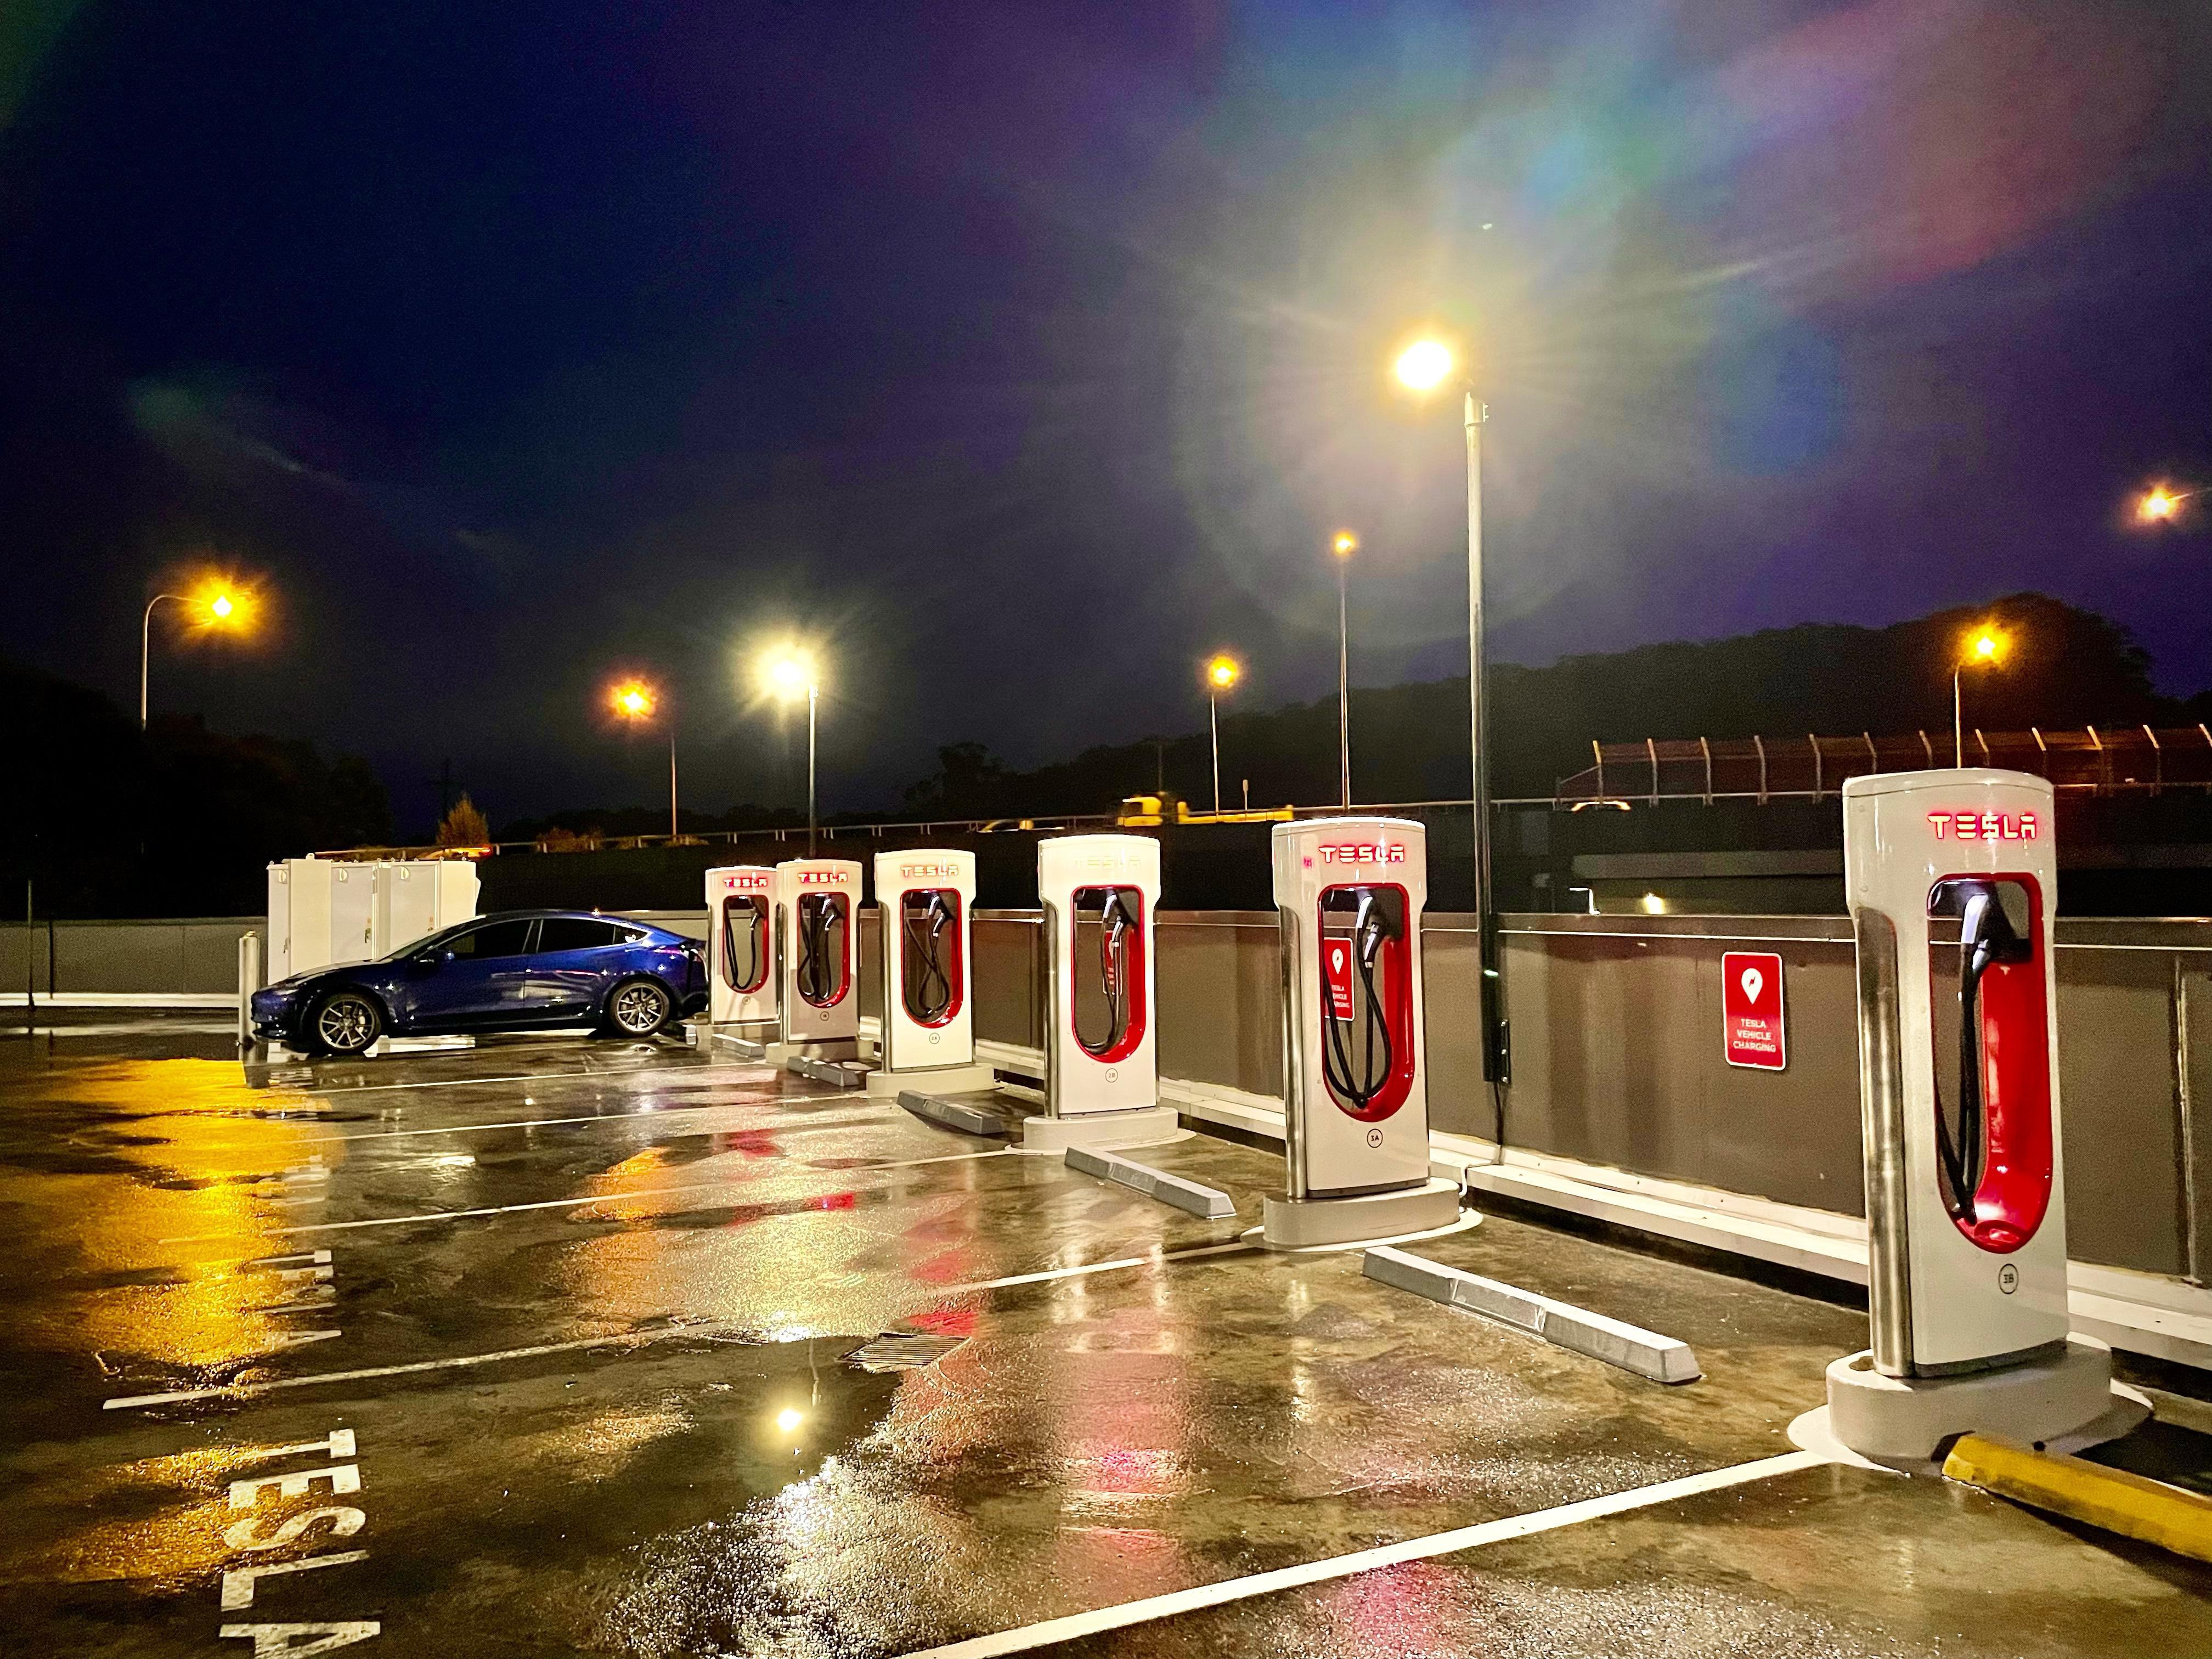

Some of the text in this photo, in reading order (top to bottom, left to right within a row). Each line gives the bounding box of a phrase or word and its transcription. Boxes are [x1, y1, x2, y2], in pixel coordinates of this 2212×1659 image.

[1928, 815, 2036, 839] TESLA
[1319, 845, 1404, 862] TESLA
[1074, 855, 1141, 869] TESLA
[900, 865, 958, 877] TESLA
[723, 878, 767, 887] TESLA
[798, 873, 848, 883] TESLA
[1741, 1018, 1767, 1028] TESLA
[1736, 1029, 1771, 1040] VEHICLE
[1733, 1041, 1776, 1053] CHARGING
[2003, 1273, 2014, 1284] 3B
[217, 1429, 381, 1659] TESLA
